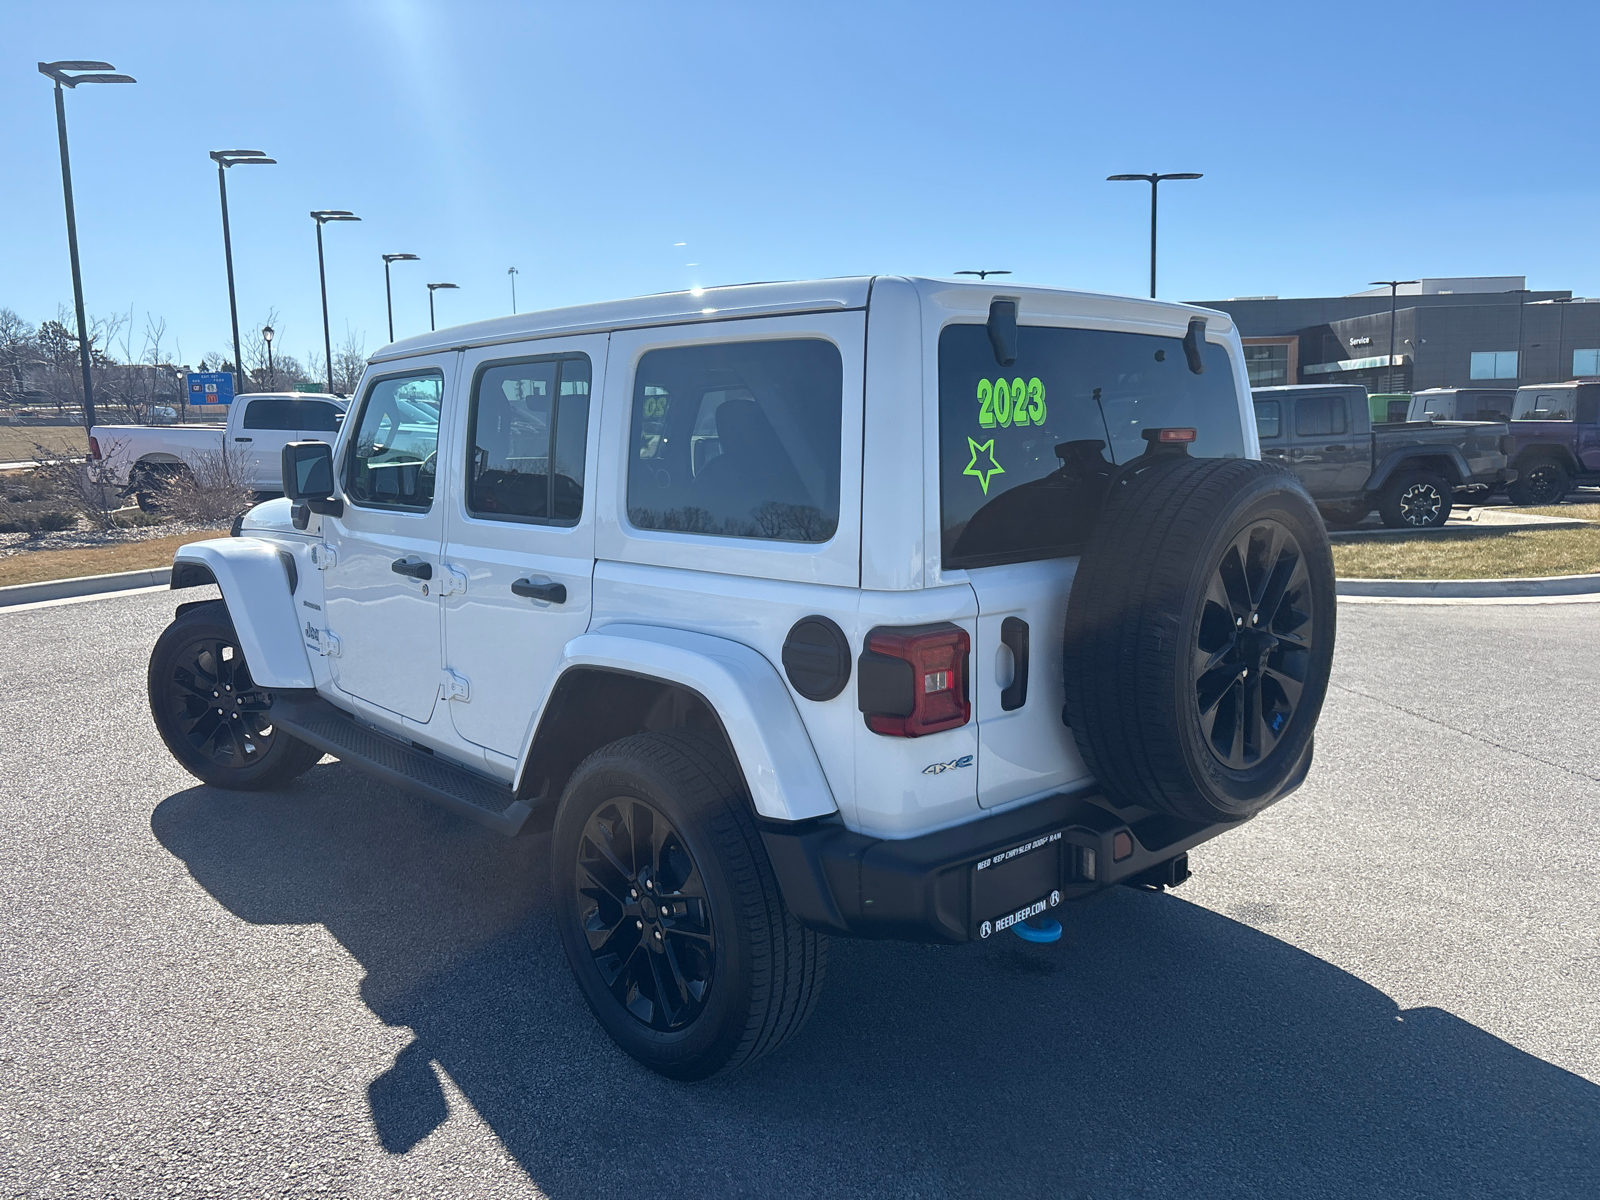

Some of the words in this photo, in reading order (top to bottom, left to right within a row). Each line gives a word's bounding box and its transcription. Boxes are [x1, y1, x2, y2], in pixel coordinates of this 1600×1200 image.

[1350, 336, 1370, 346] Service
[977, 377, 1047, 429] 2023
[977, 858, 992, 871] REED
[1005, 842, 1032, 859] CHRYSLER
[1049, 832, 1062, 843] RAM
[995, 900, 1047, 932] REEDJEEP.COM
